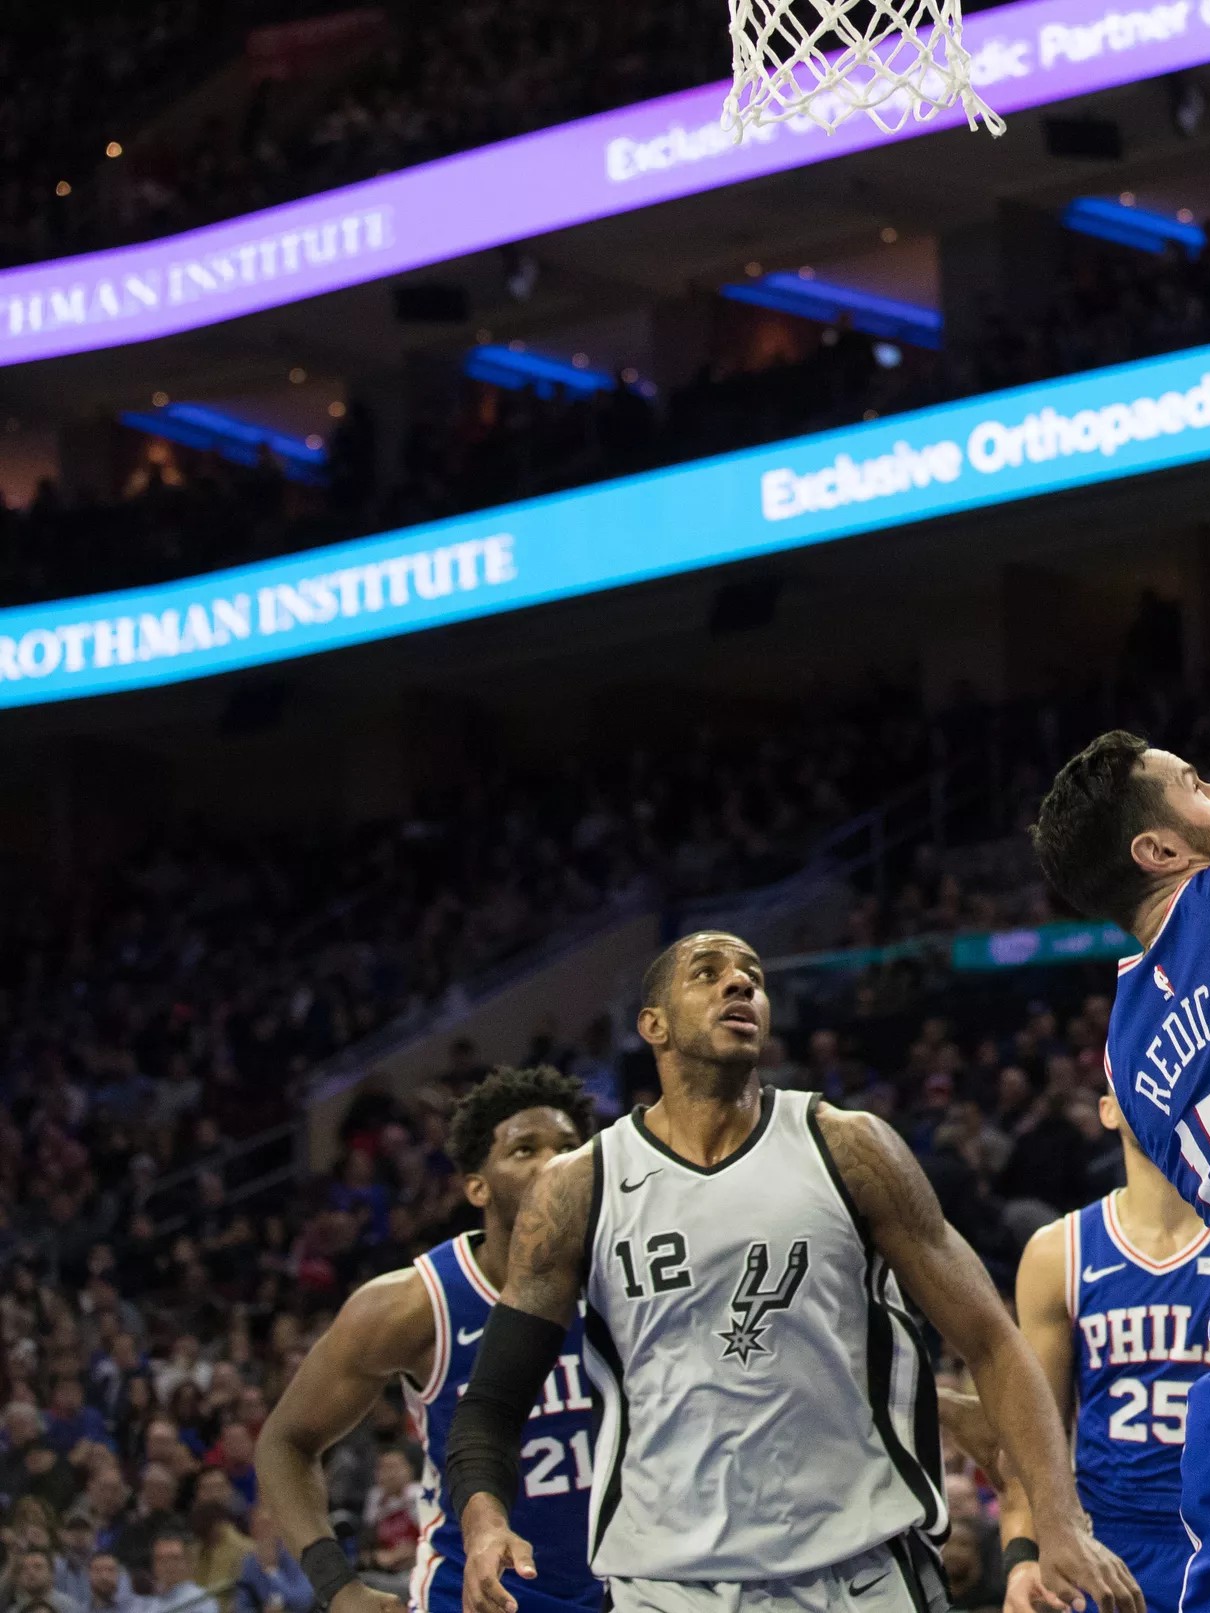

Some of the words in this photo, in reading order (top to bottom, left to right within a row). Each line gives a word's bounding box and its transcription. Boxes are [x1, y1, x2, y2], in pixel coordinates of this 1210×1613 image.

[1040, 0, 1190, 70] Partner
[166, 205, 397, 306] INSTITUTE
[761, 439, 963, 521] Exclusive
[256, 531, 518, 637] INSTITUTE
[613, 1229, 695, 1301] 12
[1109, 1377, 1196, 1445] 25
[521, 1430, 594, 1498] 21
